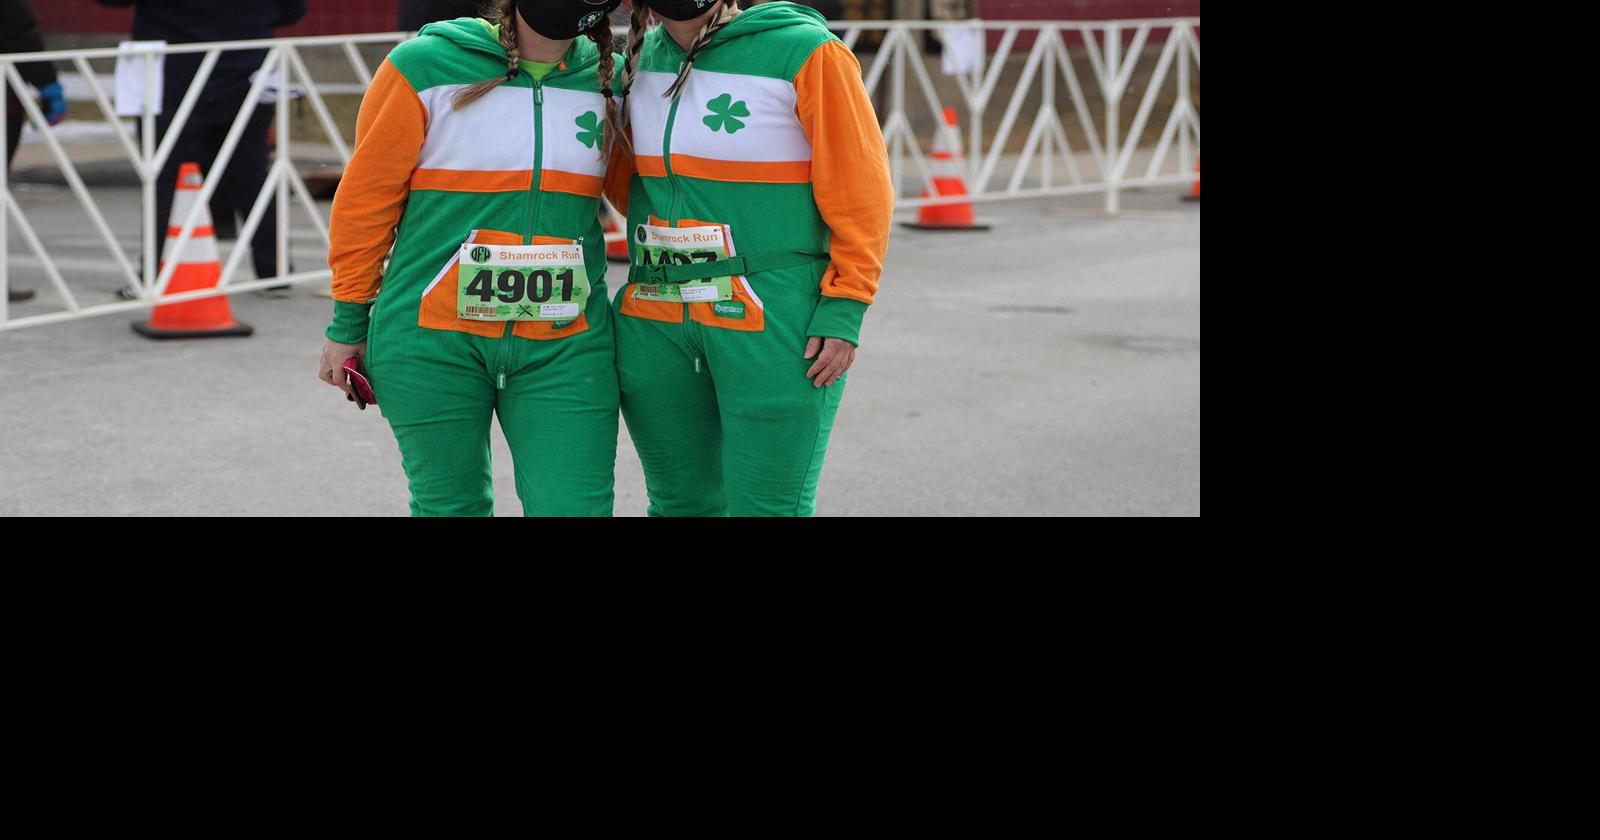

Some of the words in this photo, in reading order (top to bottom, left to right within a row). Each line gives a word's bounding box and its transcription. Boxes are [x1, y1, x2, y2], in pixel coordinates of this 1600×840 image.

[692, 233, 718, 242] Run
[499, 250, 559, 261] Shamrock
[561, 250, 581, 260] Run
[466, 268, 574, 303] 4901
